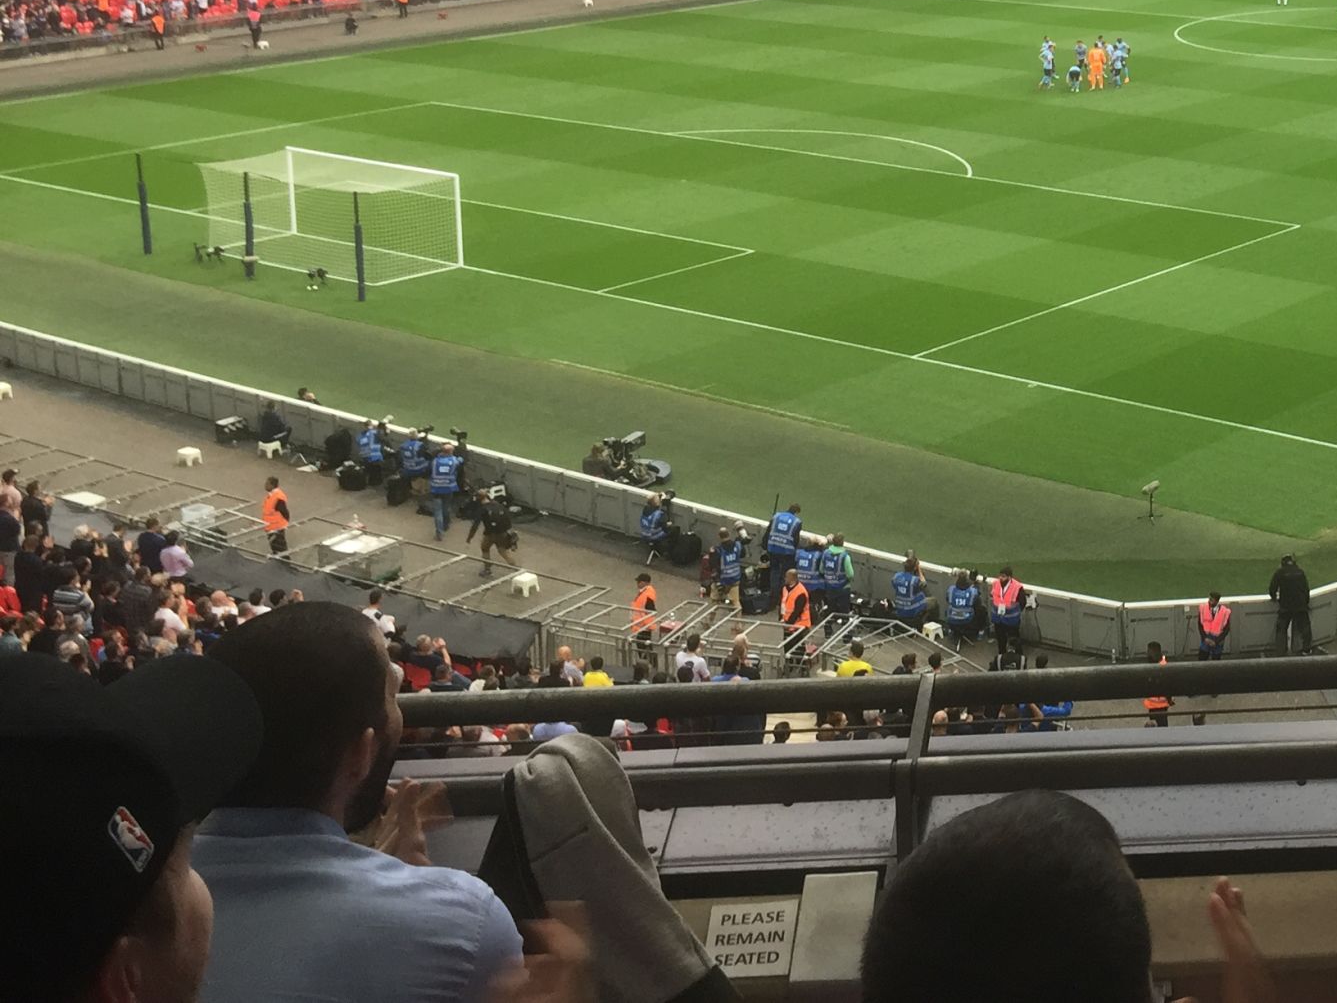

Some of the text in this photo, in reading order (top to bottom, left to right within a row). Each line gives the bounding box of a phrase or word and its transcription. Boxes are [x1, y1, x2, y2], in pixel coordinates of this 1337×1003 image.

[720, 910, 786, 926] PLEASE
[714, 930, 786, 947] REMAIN
[714, 951, 780, 967] SEATED
